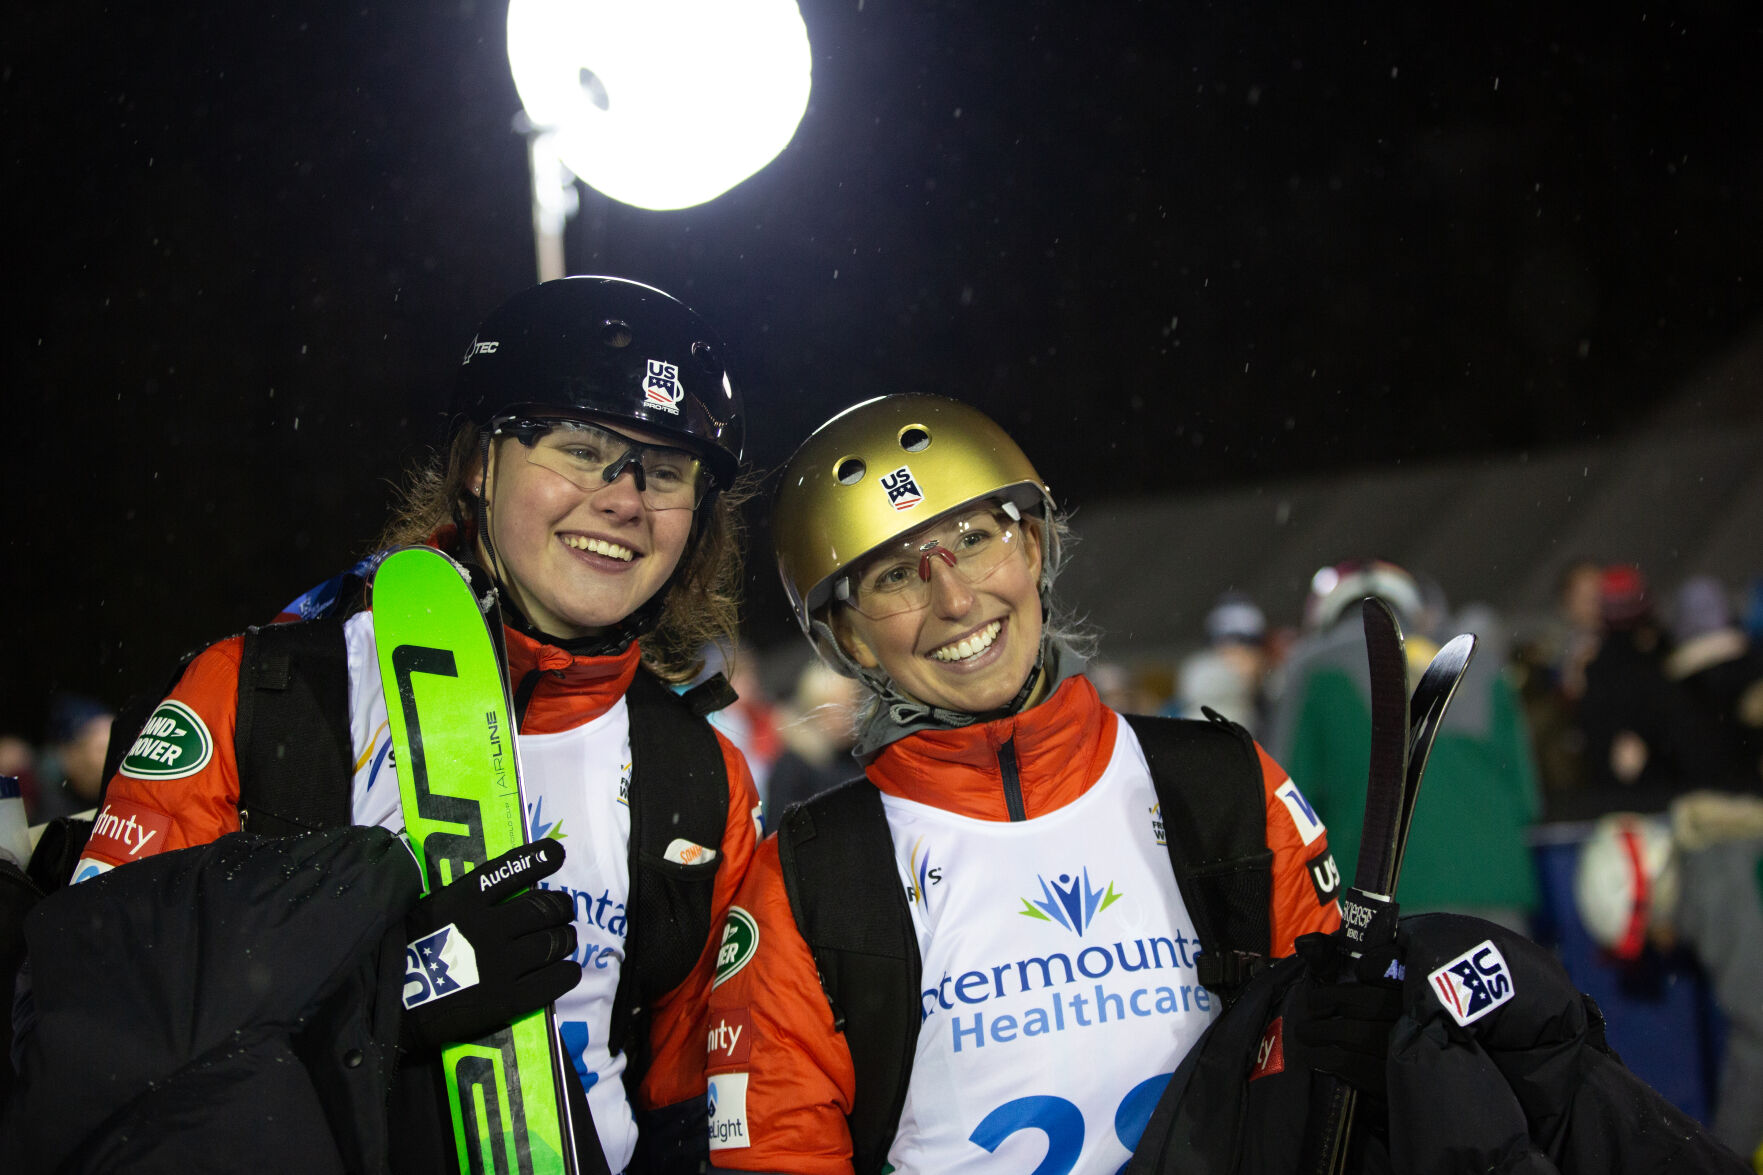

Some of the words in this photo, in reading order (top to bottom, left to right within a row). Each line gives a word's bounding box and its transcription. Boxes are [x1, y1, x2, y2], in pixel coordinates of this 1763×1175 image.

[649, 361, 676, 380] US
[881, 468, 910, 489] US
[486, 711, 507, 789] AIRLINE
[90, 804, 157, 855] finity
[480, 855, 532, 892] Auclair
[1473, 947, 1510, 1000] US
[707, 1018, 743, 1056] nity
[952, 983, 1210, 1053] Healthcare
